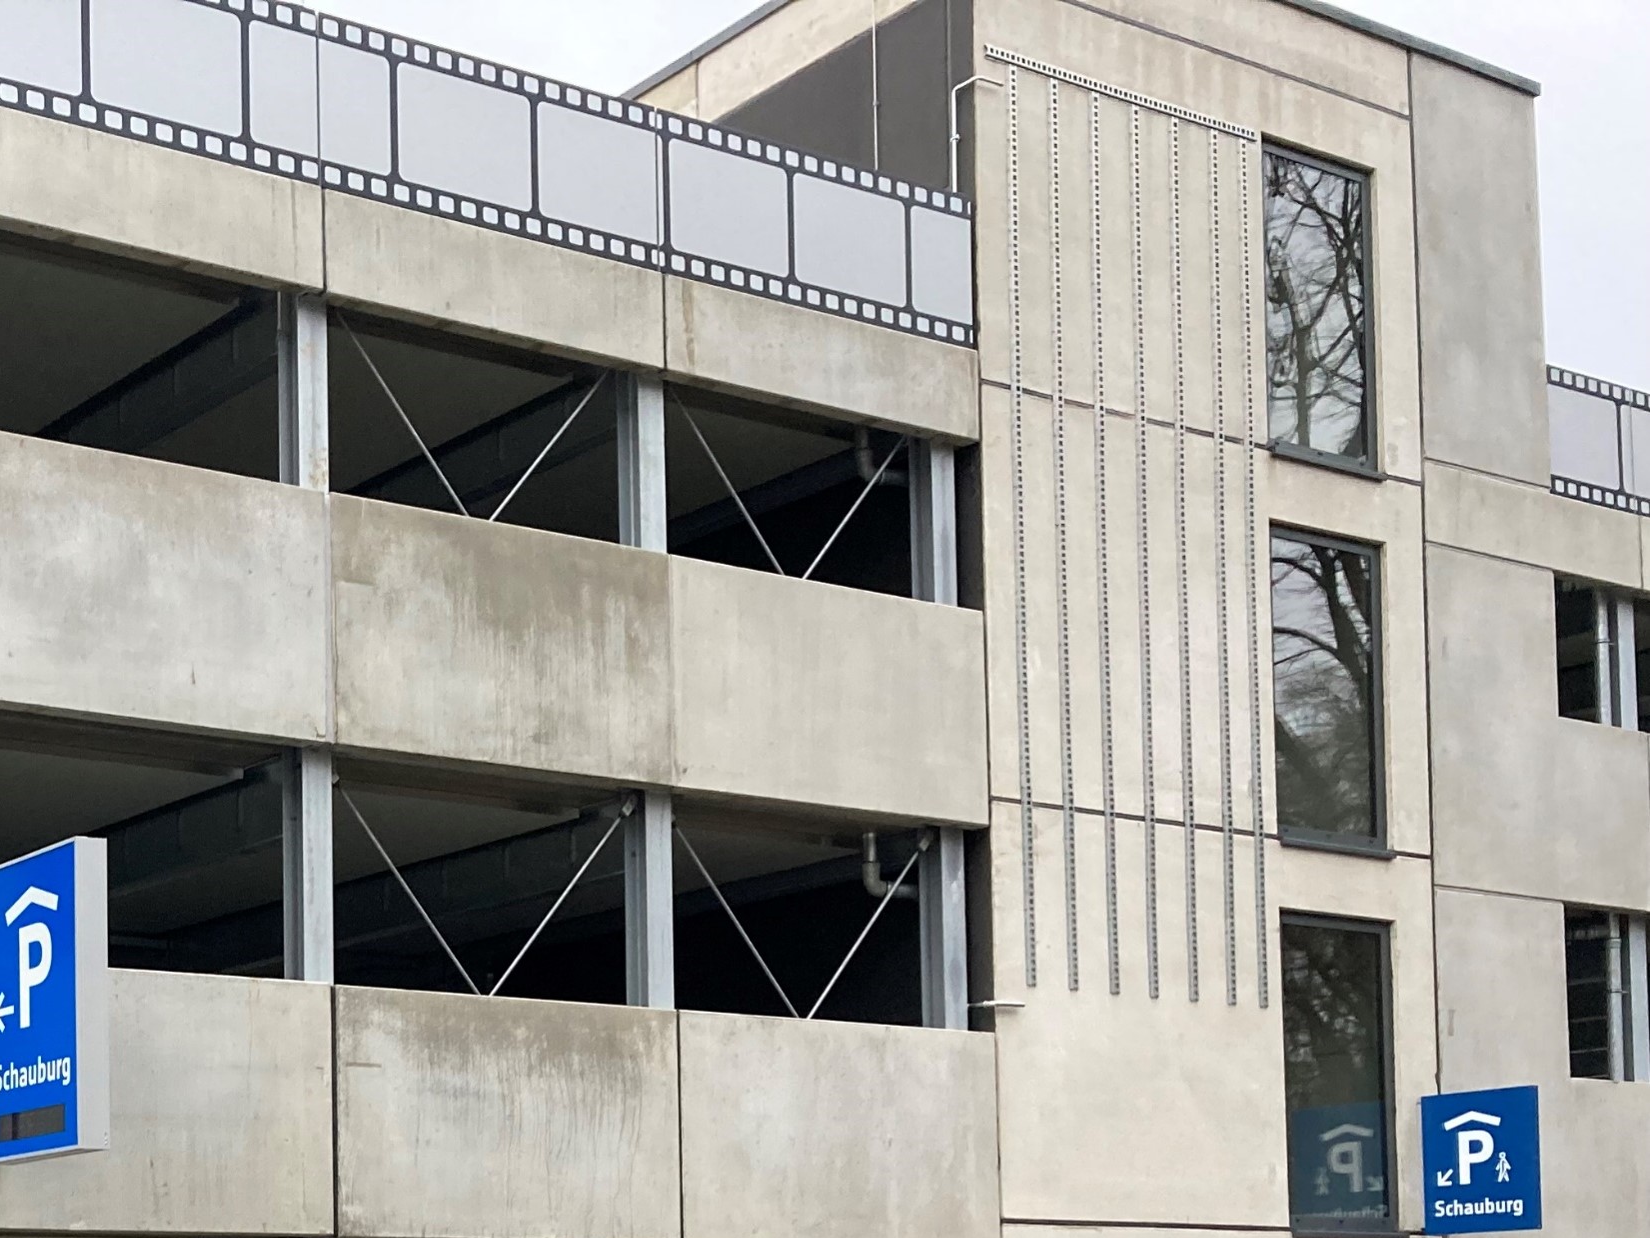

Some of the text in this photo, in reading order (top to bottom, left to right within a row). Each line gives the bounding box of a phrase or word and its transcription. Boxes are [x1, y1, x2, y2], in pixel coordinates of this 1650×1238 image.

[19, 922, 52, 1029] P
[1457, 1130, 1495, 1185] P
[1434, 1197, 1524, 1218] Schauburg
